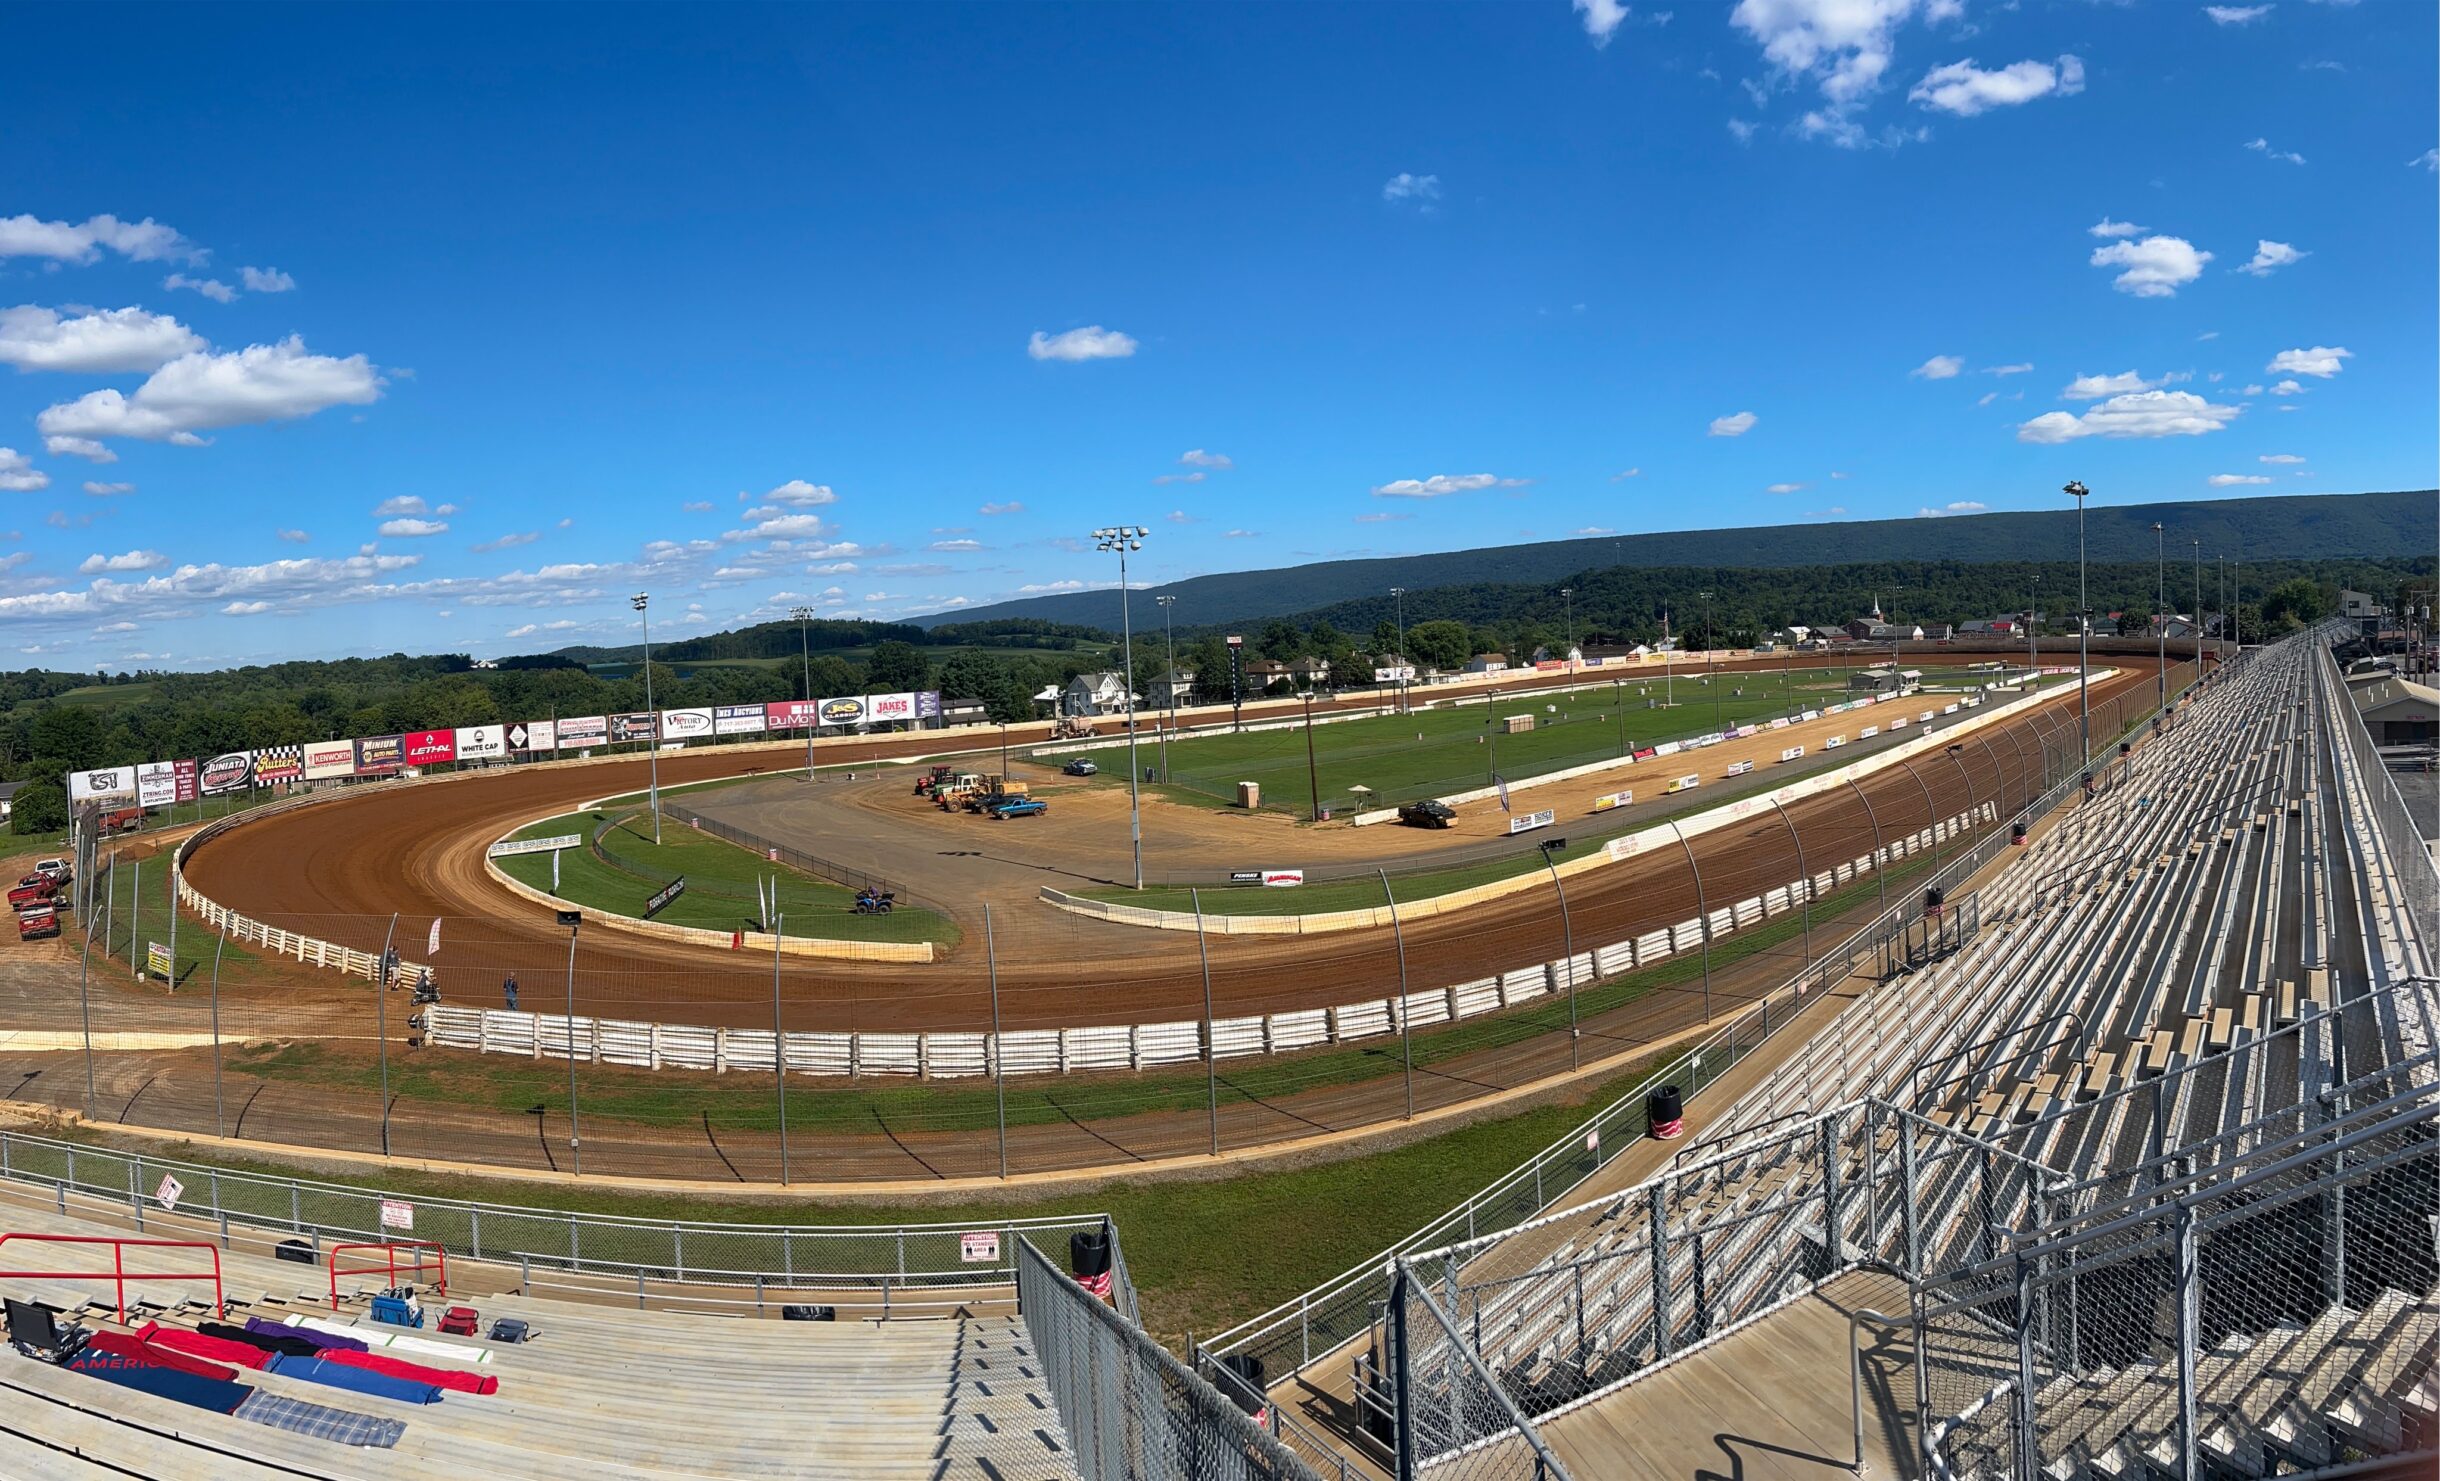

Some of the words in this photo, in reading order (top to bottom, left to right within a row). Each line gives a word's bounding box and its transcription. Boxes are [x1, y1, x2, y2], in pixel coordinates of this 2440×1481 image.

[876, 700, 908, 713] JAKES
[362, 740, 398, 752] MINIUM
[410, 744, 452, 756] LETHAL
[462, 743, 483, 753] WHITE
[485, 742, 498, 750] CAP
[315, 751, 351, 763] KENWORTH
[205, 760, 245, 774] JUNIATA
[256, 754, 297, 773] Rutter's
[141, 772, 174, 782] ZIMMERMAN
[963, 1232, 997, 1240] ATTENTION
